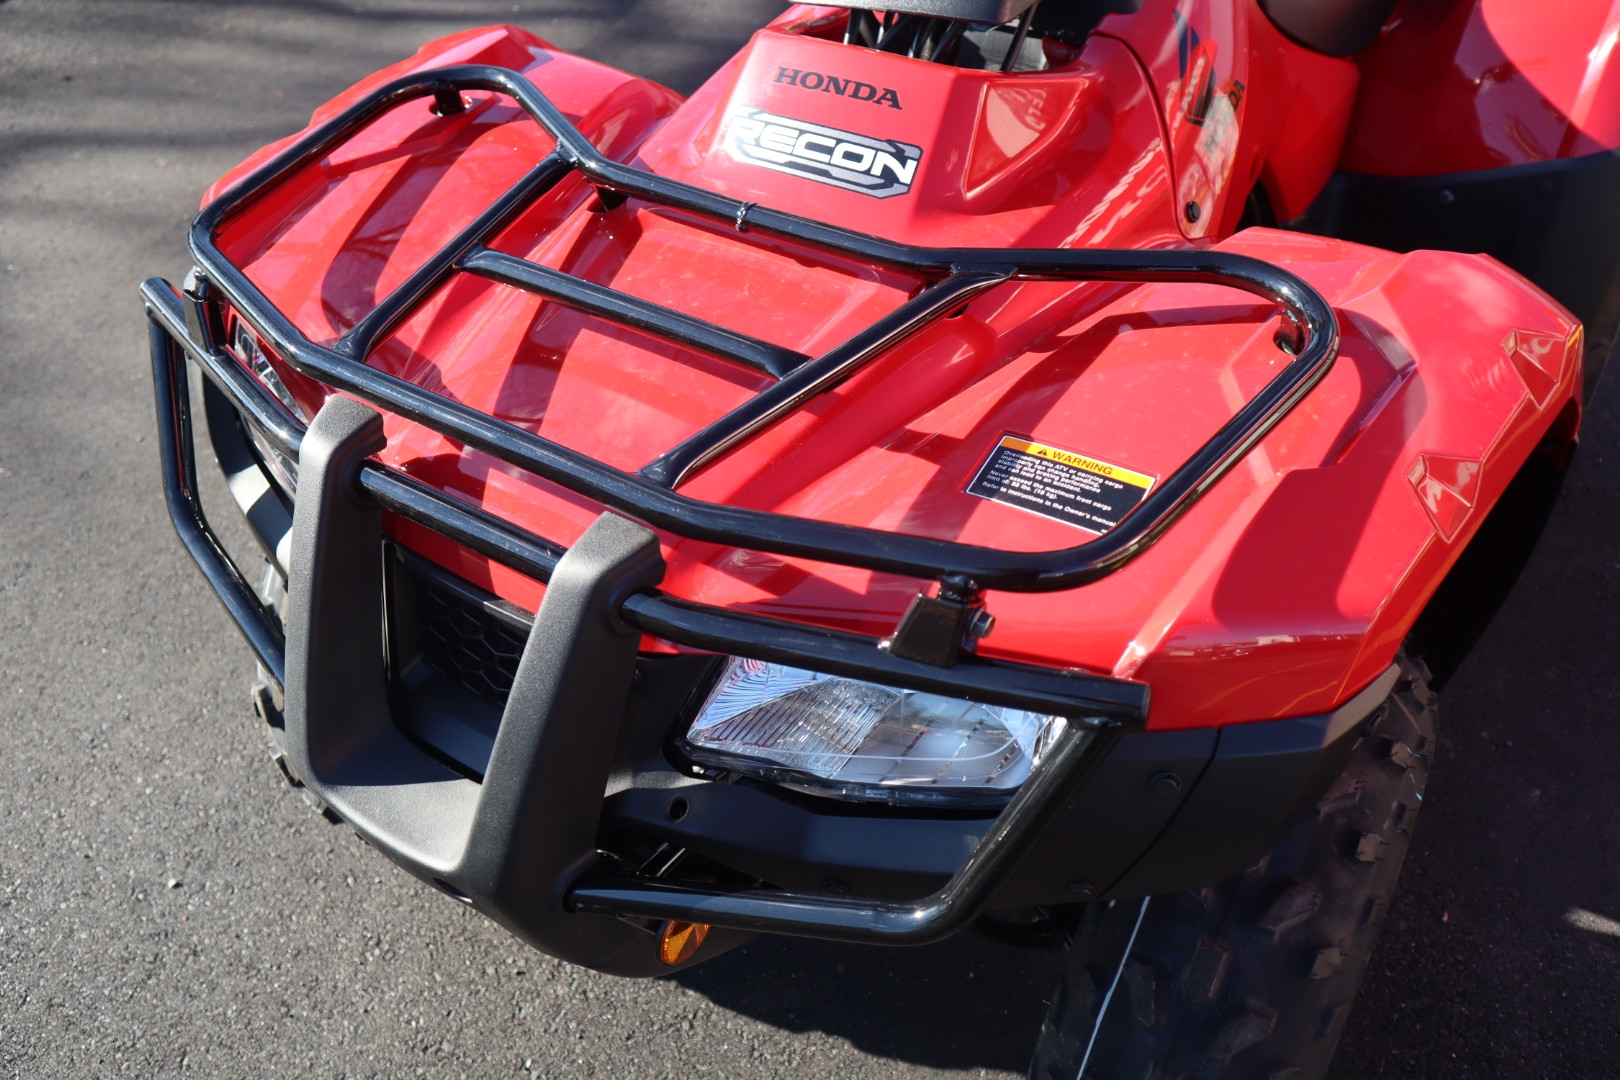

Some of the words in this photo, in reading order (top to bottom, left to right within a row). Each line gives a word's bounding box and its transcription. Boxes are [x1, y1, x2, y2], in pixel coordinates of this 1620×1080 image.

[774, 67, 902, 110] HONDA
[734, 116, 917, 184] RECON
[998, 460, 1022, 469] stability
[1036, 468, 1060, 481] braking
[1001, 455, 1033, 468] improperly
[1047, 466, 1070, 478] change
[1071, 475, 1100, 488] handling.
[1004, 451, 1040, 464] Overloading
[1078, 471, 1103, 484] carrying
[1105, 480, 1123, 489] cargo
[1053, 451, 1113, 475] WARNING
[990, 470, 1008, 478] Never
[1009, 476, 1032, 485] exceed
[1045, 486, 1075, 499] maximum
[1076, 495, 1092, 505] front
[1093, 502, 1112, 511] cargo
[1053, 480, 1081, 492] accident.
[1008, 489, 1044, 503] instructions
[1064, 506, 1090, 519] Owner's
